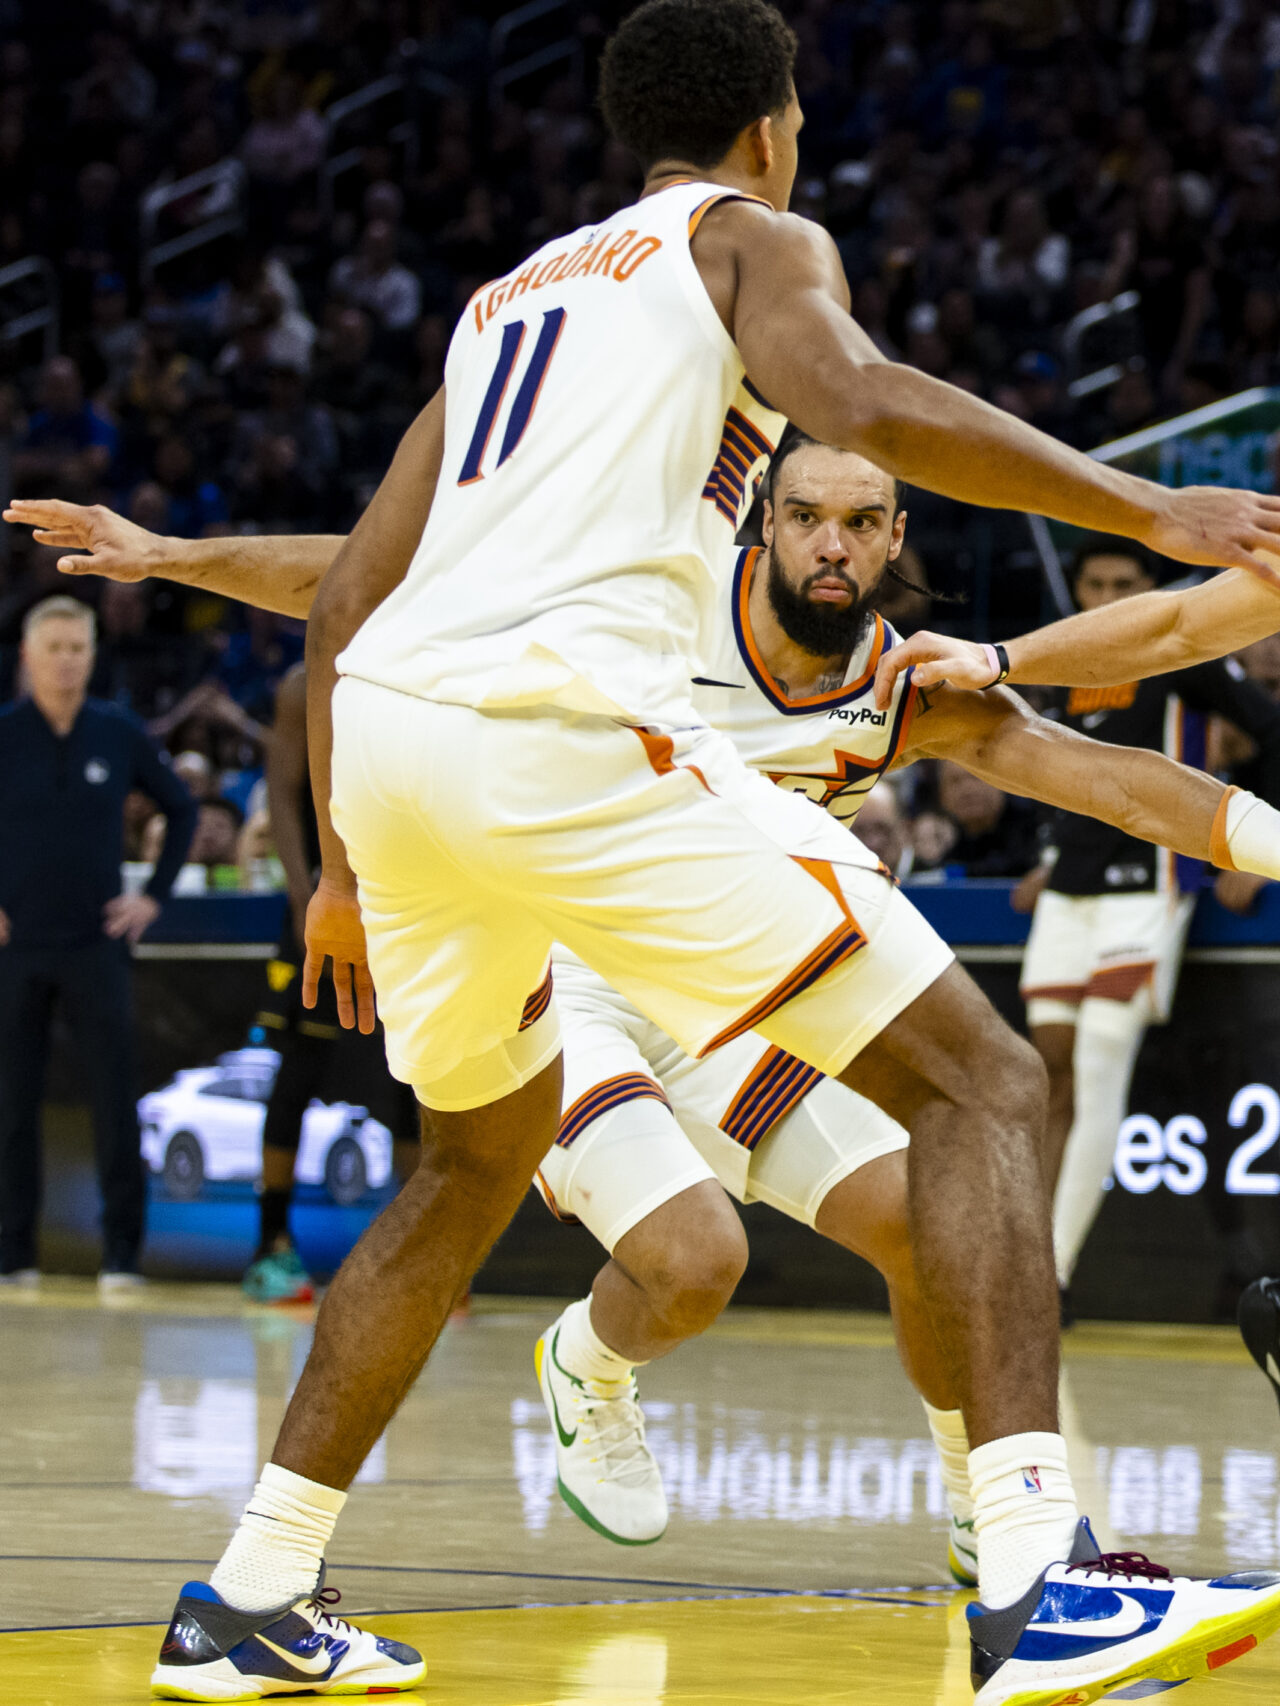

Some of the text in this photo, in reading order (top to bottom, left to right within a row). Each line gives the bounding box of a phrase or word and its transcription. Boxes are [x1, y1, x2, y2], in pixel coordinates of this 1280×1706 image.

[474, 230, 662, 335] IGHODARO
[457, 306, 567, 487] 11
[828, 708, 888, 726] PayPal
